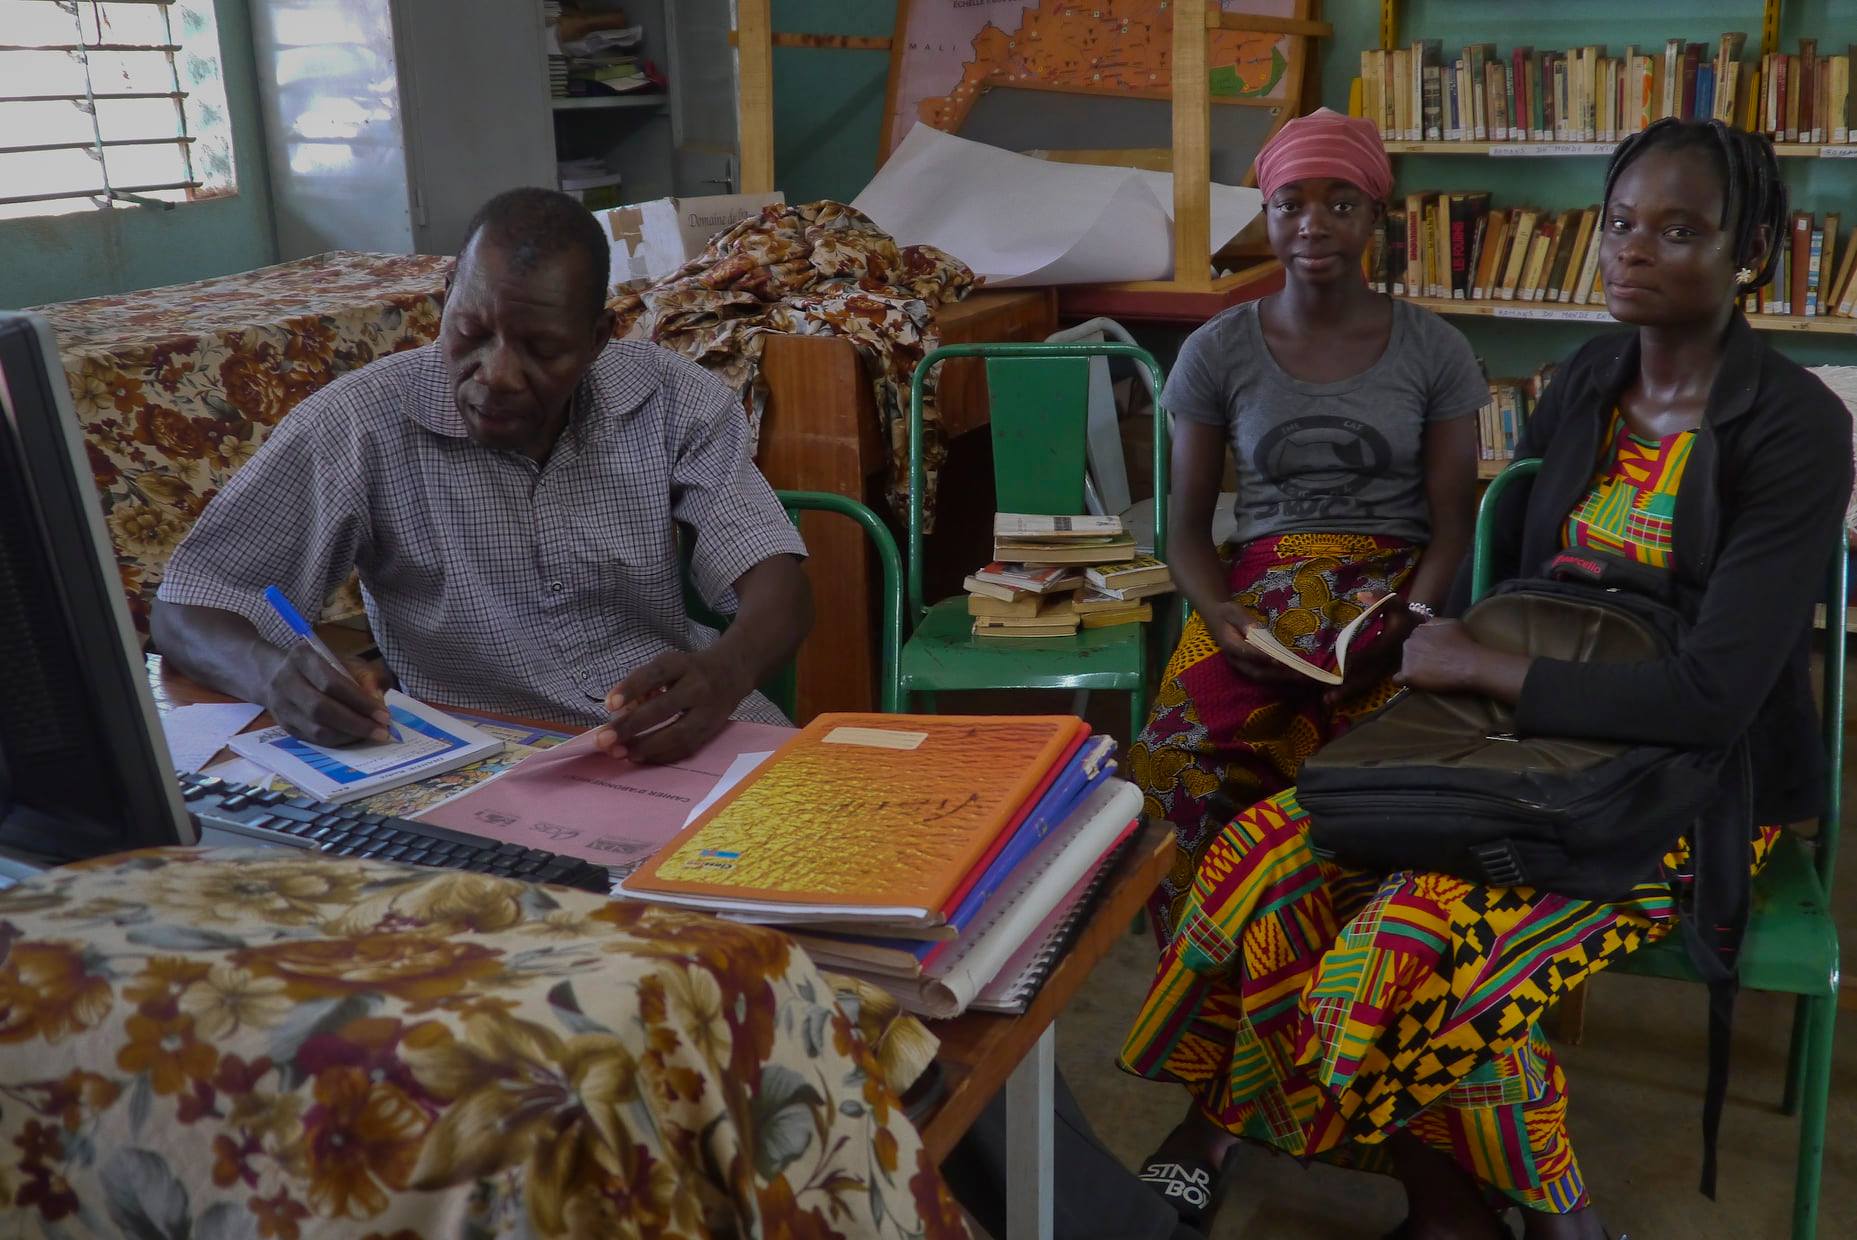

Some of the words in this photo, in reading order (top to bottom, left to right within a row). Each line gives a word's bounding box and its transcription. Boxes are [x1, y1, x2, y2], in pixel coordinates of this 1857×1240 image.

[909, 42, 957, 51] MALI
[688, 211, 725, 228] Domaine
[1343, 419, 1364, 431] CAT
[648, 789, 691, 803] CAHIER
[1138, 1163, 1211, 1195] STAR
[1165, 1180, 1211, 1209] BOY
